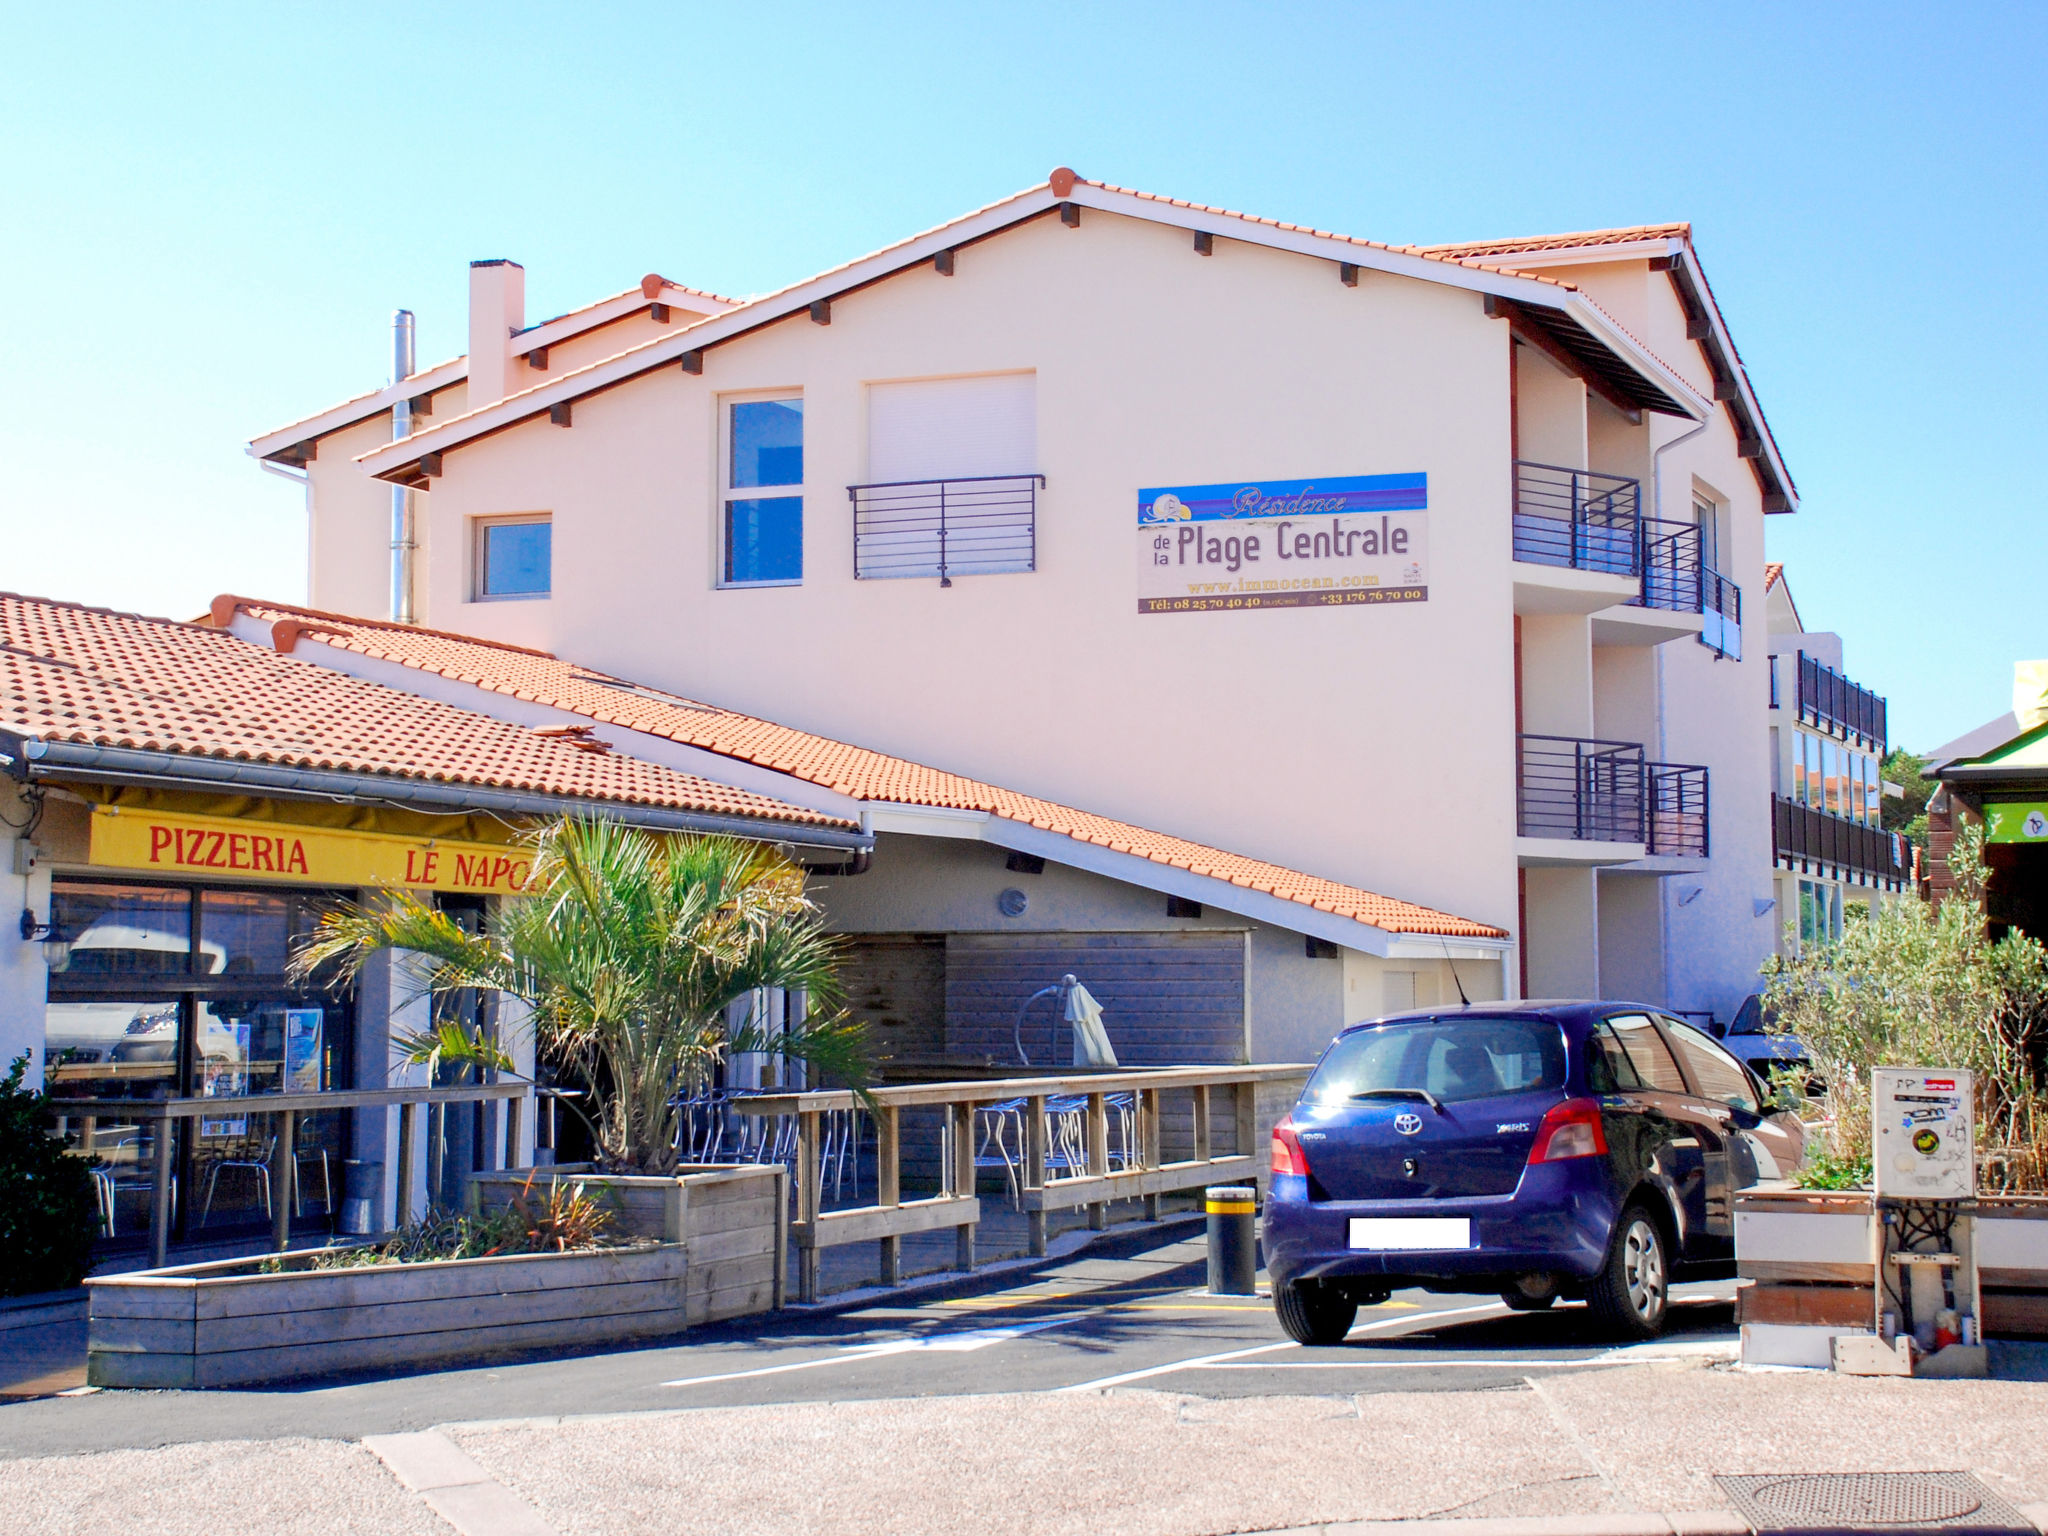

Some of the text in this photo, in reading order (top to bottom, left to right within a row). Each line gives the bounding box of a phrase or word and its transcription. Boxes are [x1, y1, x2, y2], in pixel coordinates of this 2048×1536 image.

[1220, 486, 1347, 520] Résidence
[1153, 534, 1171, 550] de
[1178, 515, 1409, 573] Plage Centrale
[1153, 552, 1169, 566] la
[1187, 574, 1379, 594] www.immocean.com
[1149, 599, 1170, 610] Tél:
[1174, 599, 1189, 610] 08
[1192, 599, 1207, 610] 25
[1209, 599, 1223, 610] 70
[1226, 598, 1242, 609] 40
[1245, 597, 1260, 608] 40
[1320, 593, 1343, 605] +33
[1386, 590, 1401, 602] 70
[1404, 590, 1421, 600] 00
[149, 825, 309, 875] PIZZERIA
[405, 849, 439, 884] LE
[1302, 1133, 1327, 1141] TOYOTA
